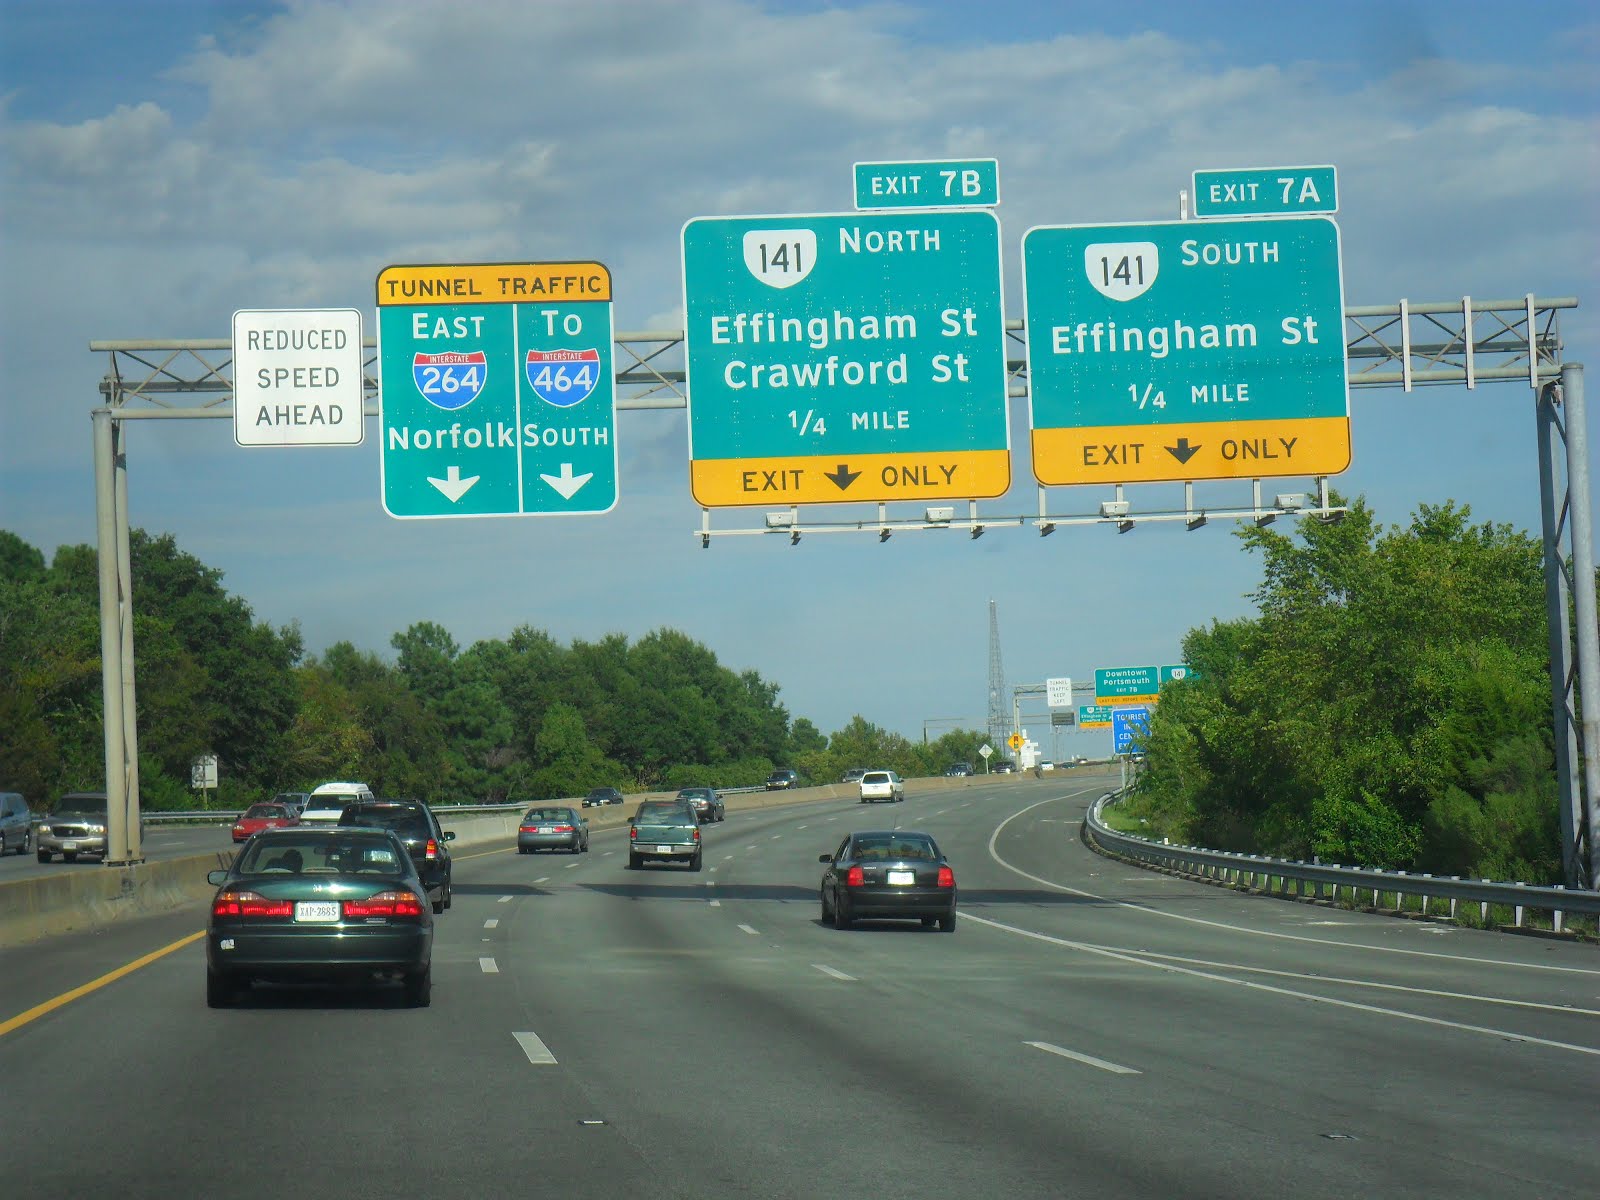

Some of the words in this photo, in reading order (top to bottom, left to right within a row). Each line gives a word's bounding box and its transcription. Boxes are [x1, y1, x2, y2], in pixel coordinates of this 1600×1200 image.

[871, 176, 922, 195] EXIT
[939, 170, 982, 197] 7B
[1210, 183, 1259, 203] EXIT
[1277, 176, 1321, 204] 7A
[759, 242, 802, 274] 141
[839, 227, 941, 254] NORTH
[1100, 255, 1144, 287] 141
[1181, 239, 1279, 266] SOUTH
[386, 278, 482, 298] TUNNEL
[498, 275, 602, 295] TRAFFIC
[412, 312, 486, 339] EAST
[540, 309, 582, 337] TO
[711, 309, 918, 350] Effingham
[941, 308, 977, 337] St
[248, 329, 347, 351] REDUCED
[1052, 319, 1257, 359] Effingham
[1281, 315, 1319, 345] St
[429, 353, 470, 364] INTERSTATE
[542, 351, 583, 362] INTERSTATE
[257, 367, 340, 389] SPEED
[422, 366, 480, 394] 264
[533, 364, 593, 393] 464
[723, 353, 908, 389] Crawford
[931, 353, 970, 383] St
[1128, 383, 1167, 410] 1/4
[1191, 383, 1250, 403] MILE
[255, 404, 344, 426] AHEAD
[787, 410, 827, 436] 1/4
[851, 410, 910, 431] MILE
[388, 422, 515, 451] Norfolk
[523, 423, 609, 448] SOUTH
[1083, 442, 1145, 466] EXIT
[1220, 437, 1299, 461] ONLY
[742, 469, 805, 493] EXIT
[881, 464, 959, 488] ONLY
[1103, 677, 1150, 686] Portsmouth
[1105, 670, 1147, 678] Downtown
